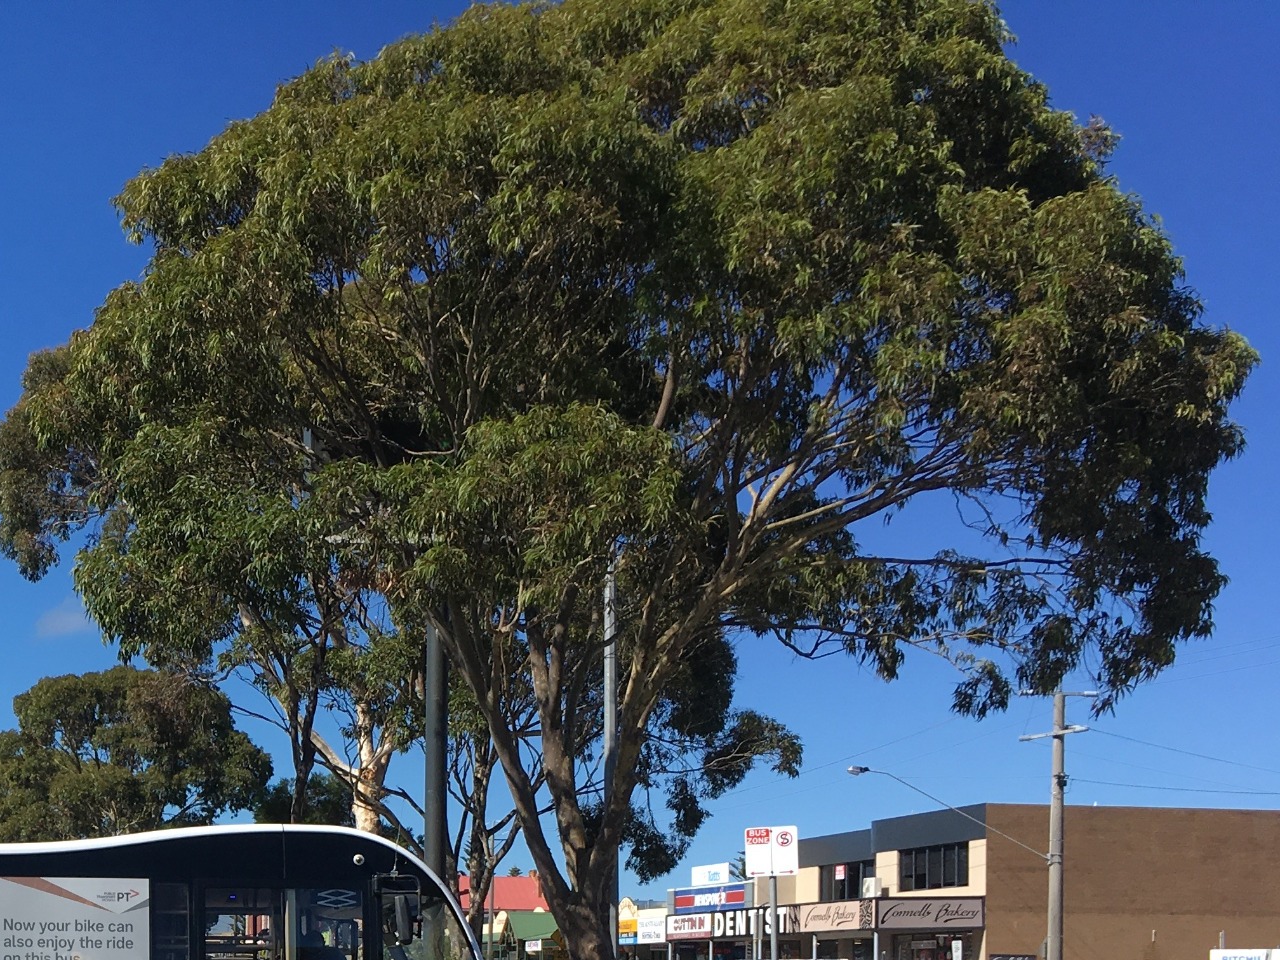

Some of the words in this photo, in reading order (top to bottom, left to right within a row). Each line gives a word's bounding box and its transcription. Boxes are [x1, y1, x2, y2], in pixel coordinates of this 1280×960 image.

[749, 829, 767, 837] BUS
[714, 906, 787, 937] DENTST
[831, 905, 857, 927] Bakery
[934, 903, 980, 923] Bakery
[3, 918, 36, 931] Now
[39, 921, 71, 935] your
[74, 919, 104, 932] bike
[108, 922, 134, 933] can
[3, 935, 34, 948] also
[37, 935, 75, 951] enjoy
[79, 936, 102, 949] the
[106, 936, 134, 949] ride
